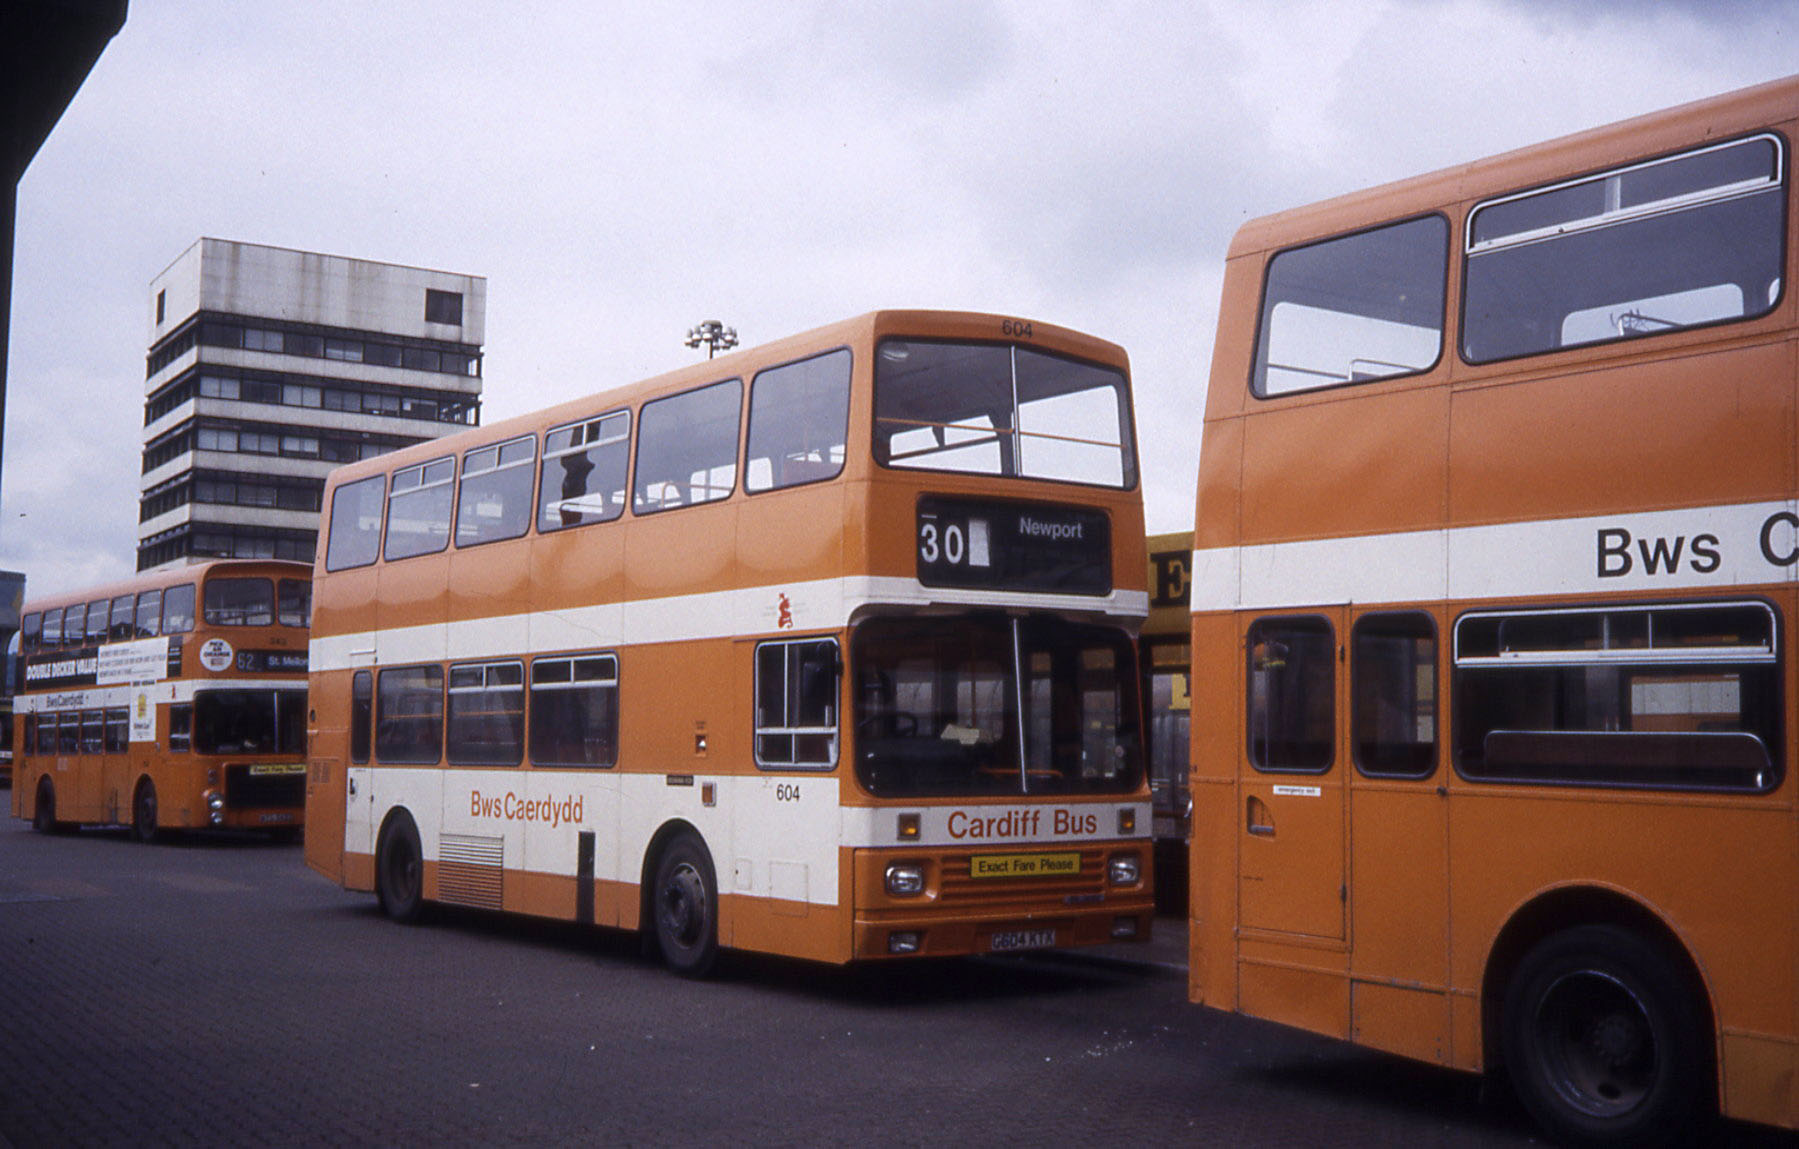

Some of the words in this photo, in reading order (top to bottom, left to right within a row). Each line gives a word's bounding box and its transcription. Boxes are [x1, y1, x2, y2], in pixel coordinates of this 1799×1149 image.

[1002, 320, 1033, 339] 604
[921, 523, 963, 563] 30
[1020, 517, 1082, 540] Newport
[1597, 528, 1721, 578] Bws
[1760, 512, 1799, 567] C
[776, 784, 800, 801] 604
[471, 790, 502, 818] Bws
[504, 791, 583, 829] Caerdydd
[947, 809, 1040, 839] Cardiff
[1053, 809, 1098, 835] Bus
[979, 860, 1008, 872] Exact
[1013, 859, 1036, 871] Fare
[1040, 858, 1074, 870] Please
